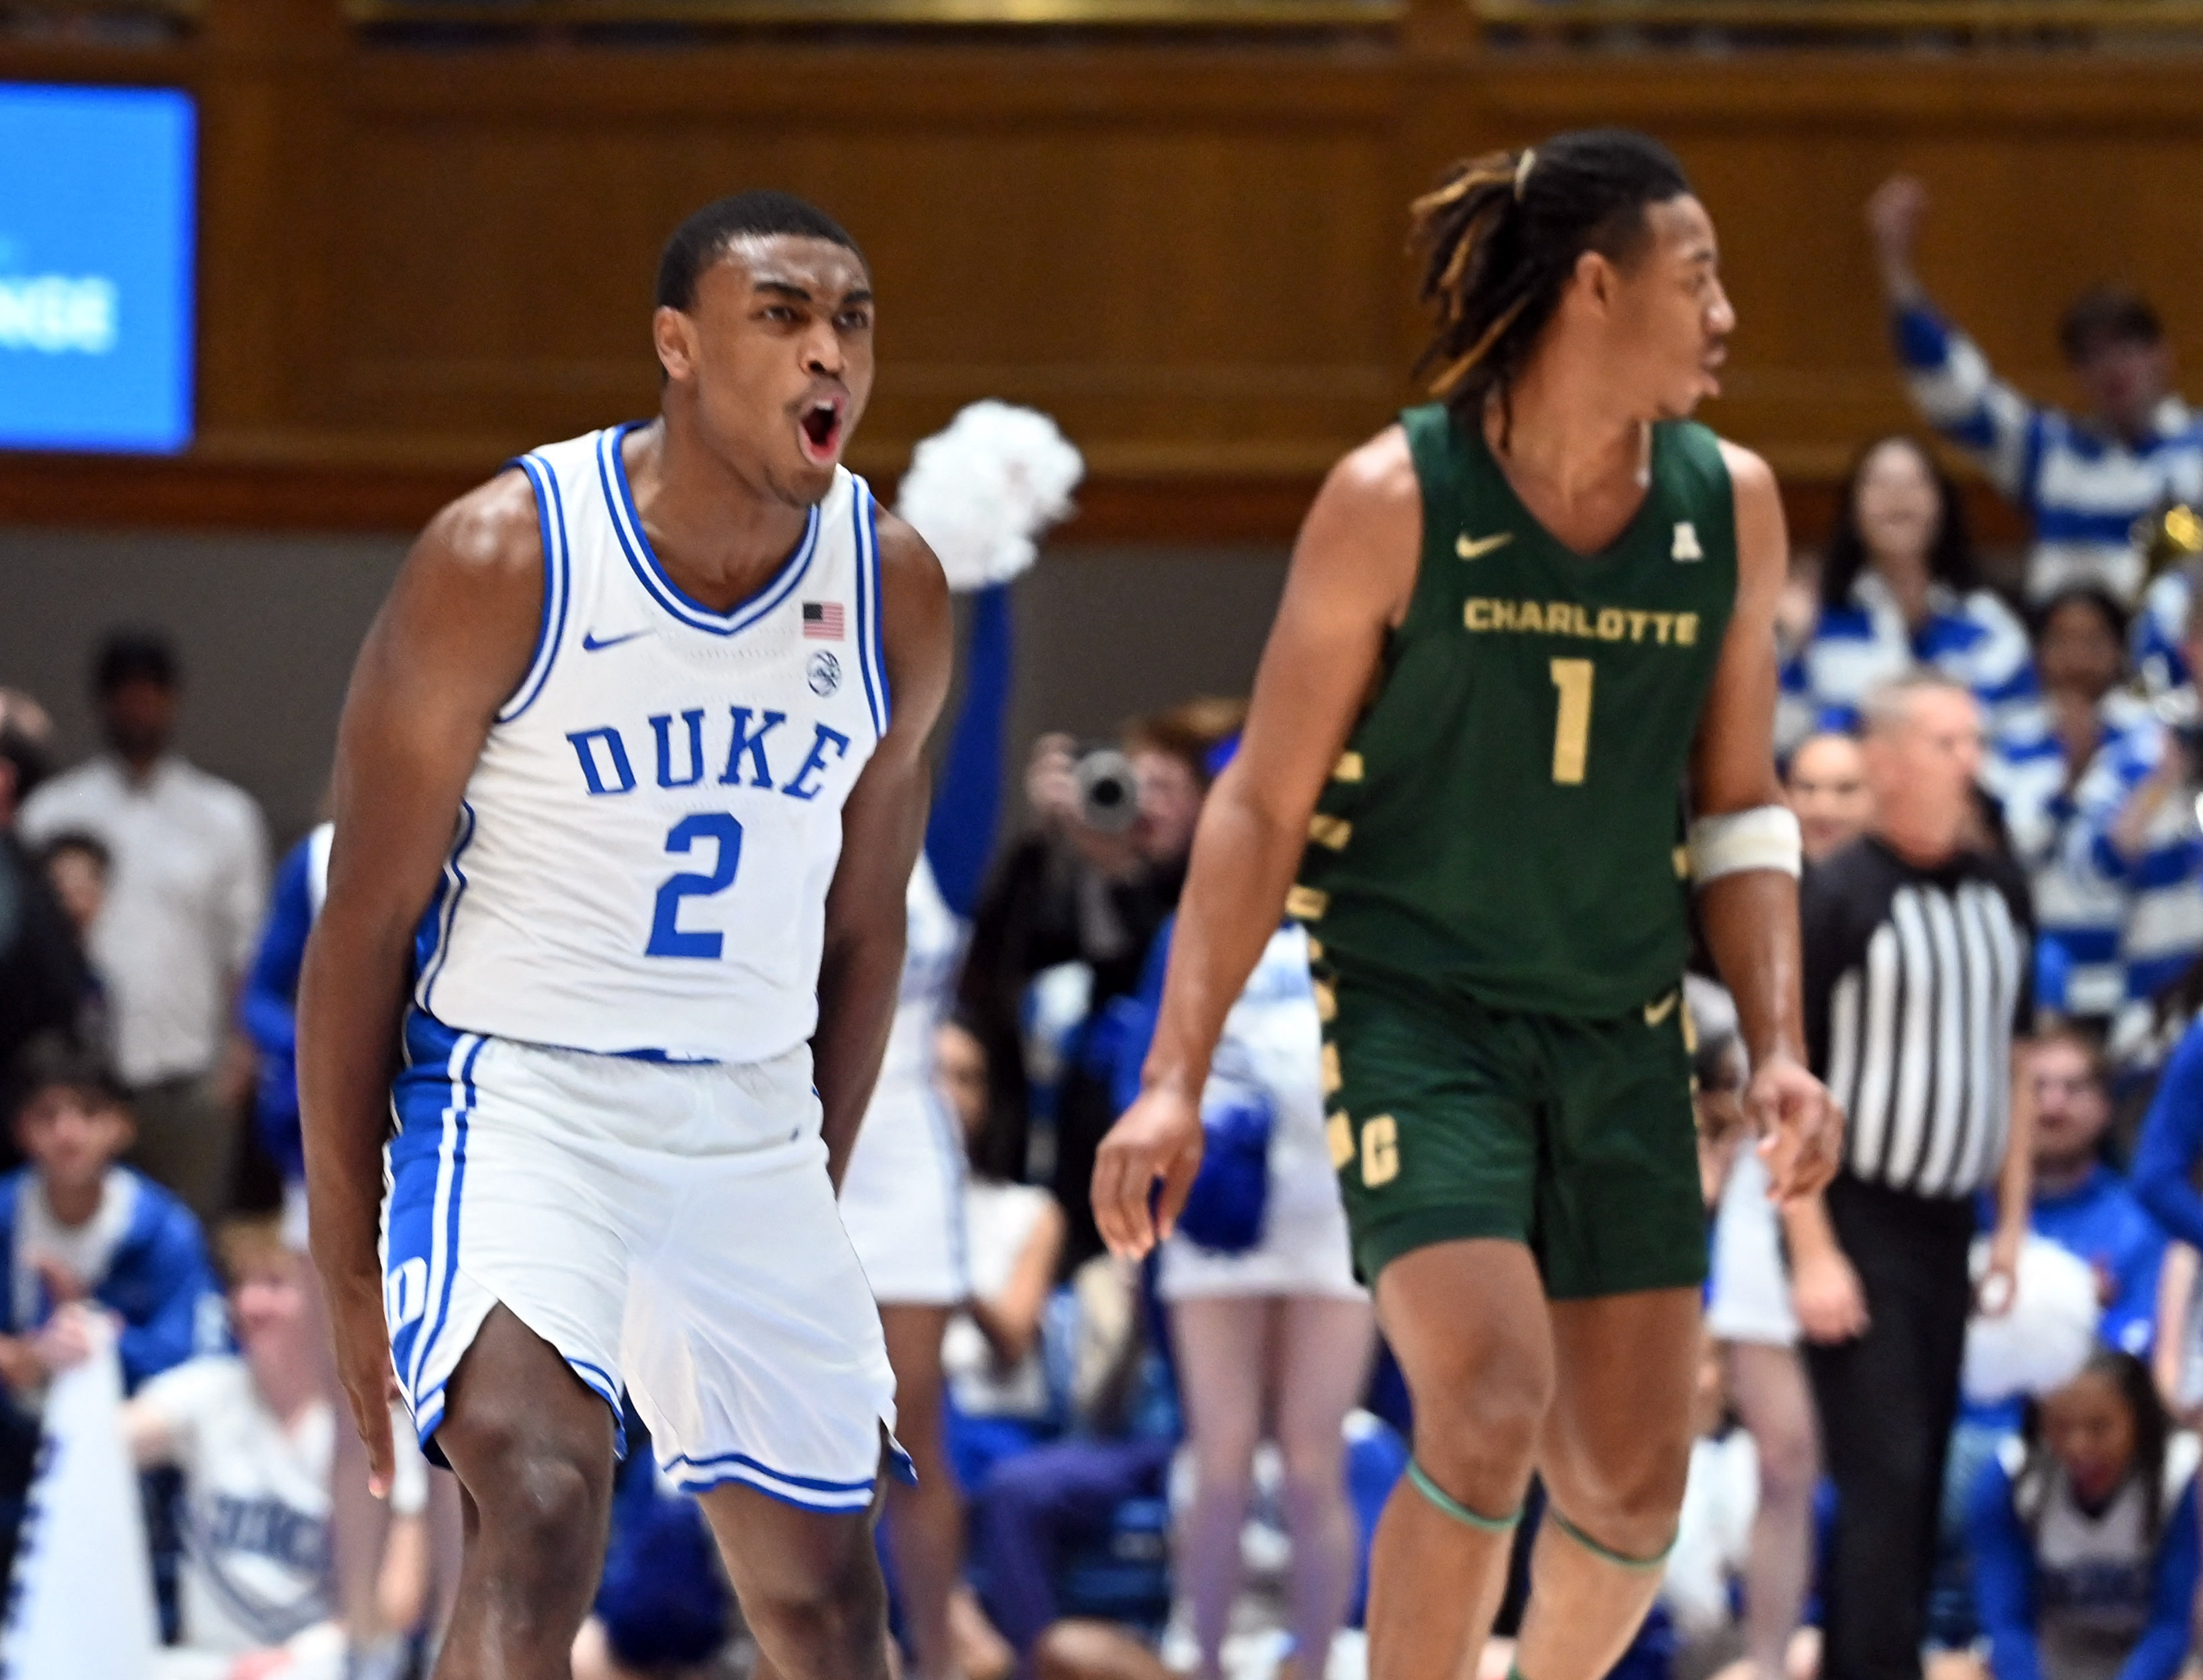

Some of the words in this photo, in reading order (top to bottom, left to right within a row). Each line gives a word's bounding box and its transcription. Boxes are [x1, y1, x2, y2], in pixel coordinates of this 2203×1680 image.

[1464, 597, 1699, 647] CHARLOTTE
[565, 705, 850, 802] DUKE
[1550, 657, 1594, 787] 1
[644, 811, 743, 960] 2
